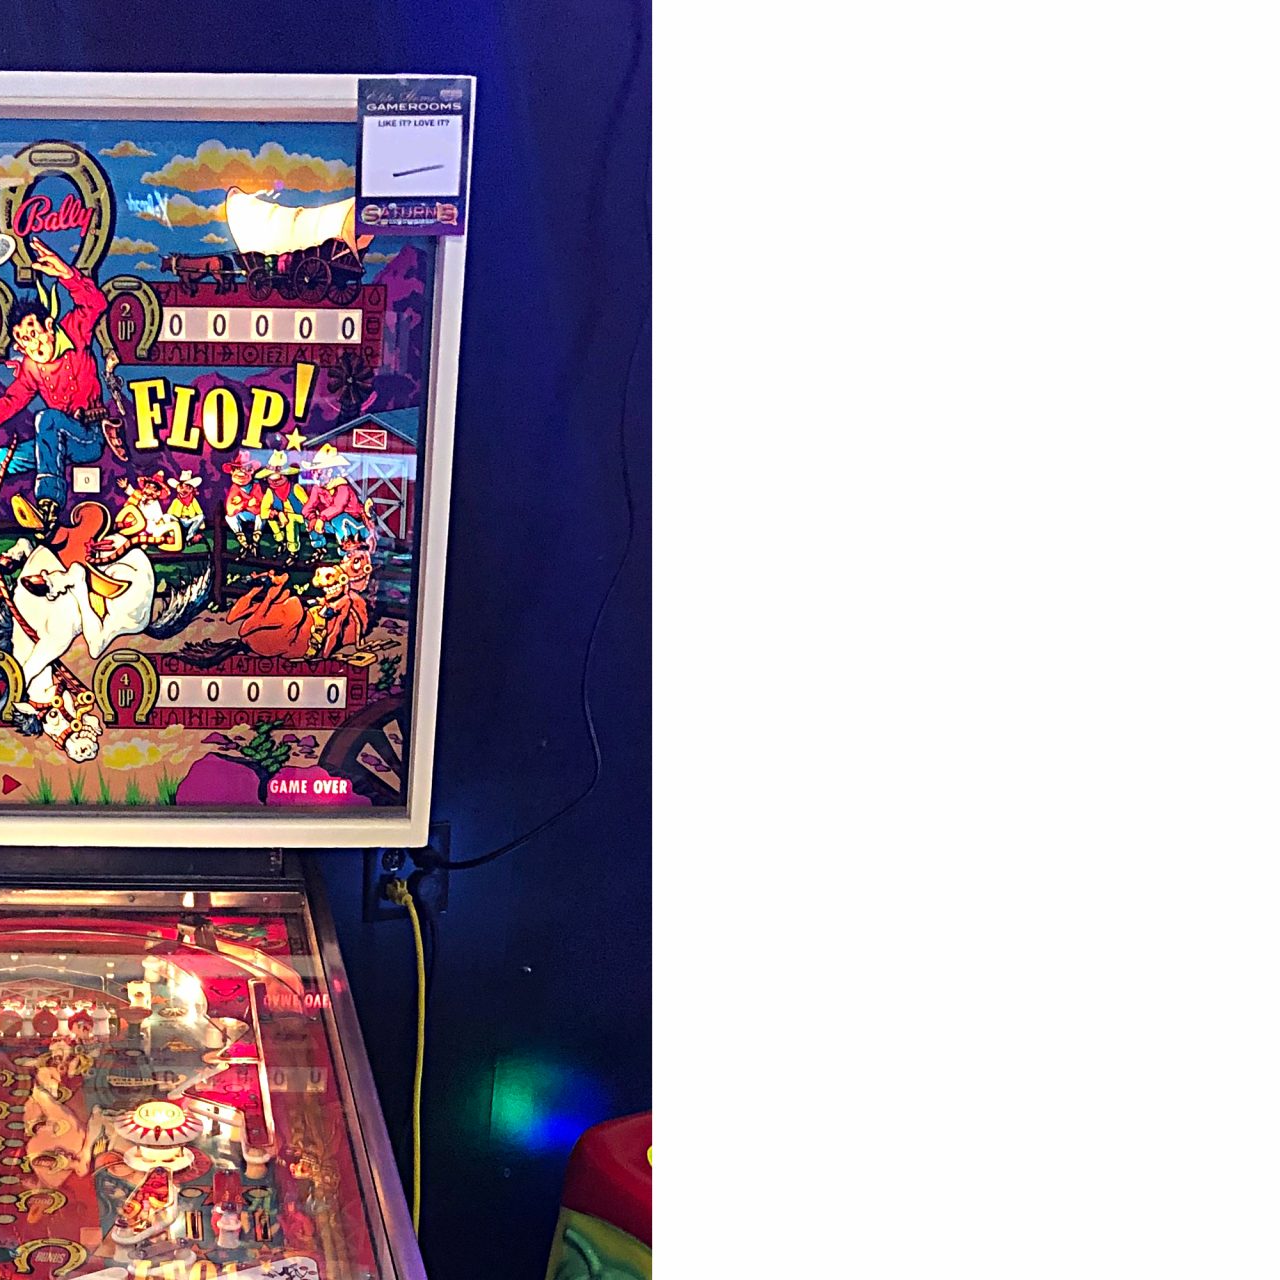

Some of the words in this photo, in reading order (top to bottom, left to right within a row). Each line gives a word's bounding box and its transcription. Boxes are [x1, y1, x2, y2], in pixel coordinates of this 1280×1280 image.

[366, 102, 462, 111] GAMEROOMS
[378, 119, 397, 127] LIKE
[399, 119, 412, 127] IT?
[414, 119, 435, 127] LOVE
[437, 119, 450, 127] IT?
[13, 194, 94, 238] Bally
[120, 303, 131, 317] 2
[118, 321, 135, 341] UP
[129, 362, 316, 451] FLOP!
[120, 673, 130, 686] 4
[118, 688, 135, 708] UP
[269, 779, 308, 795] GAME
[312, 780, 349, 795] OVER
[35, 1251, 66, 1264] BONUS
